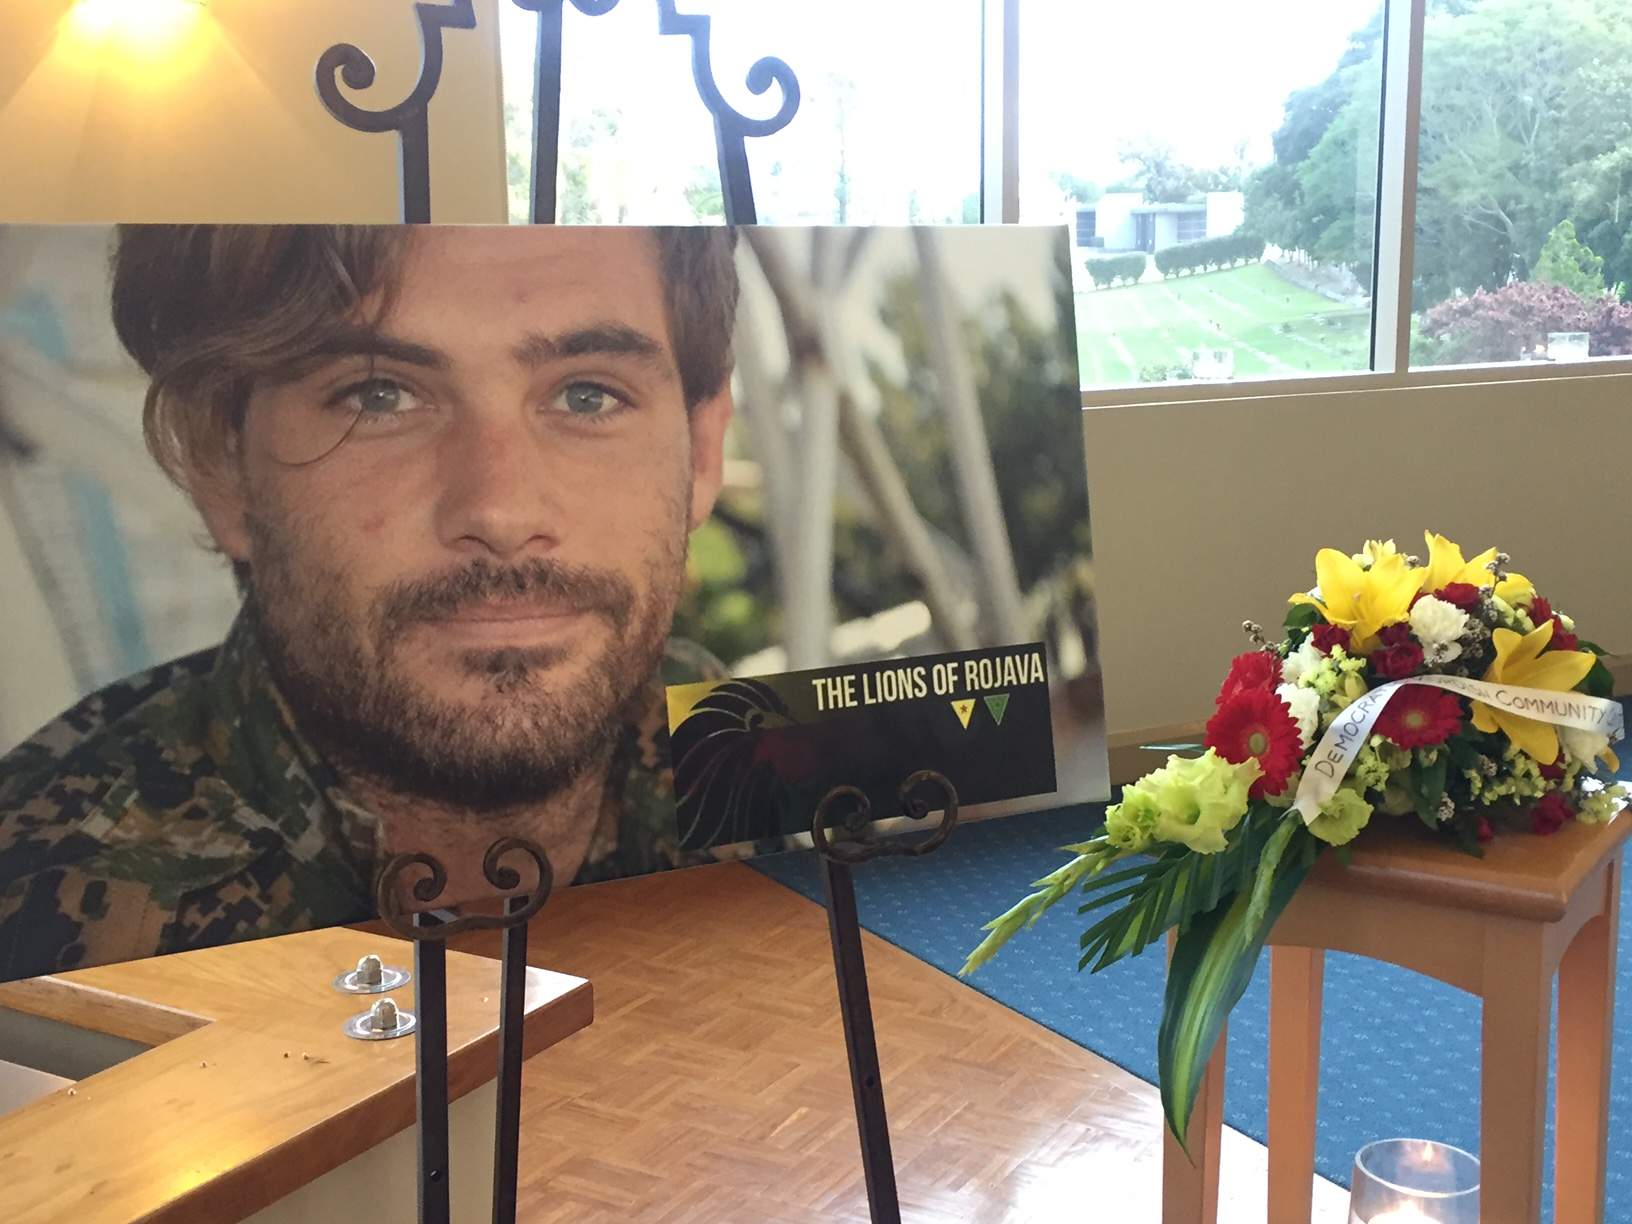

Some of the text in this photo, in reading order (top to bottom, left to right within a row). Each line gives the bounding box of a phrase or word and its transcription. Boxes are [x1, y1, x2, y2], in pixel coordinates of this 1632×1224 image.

[812, 652, 1045, 711] THE LIONS OF ROJAVA
[1495, 690, 1607, 725] COMMUNITY
